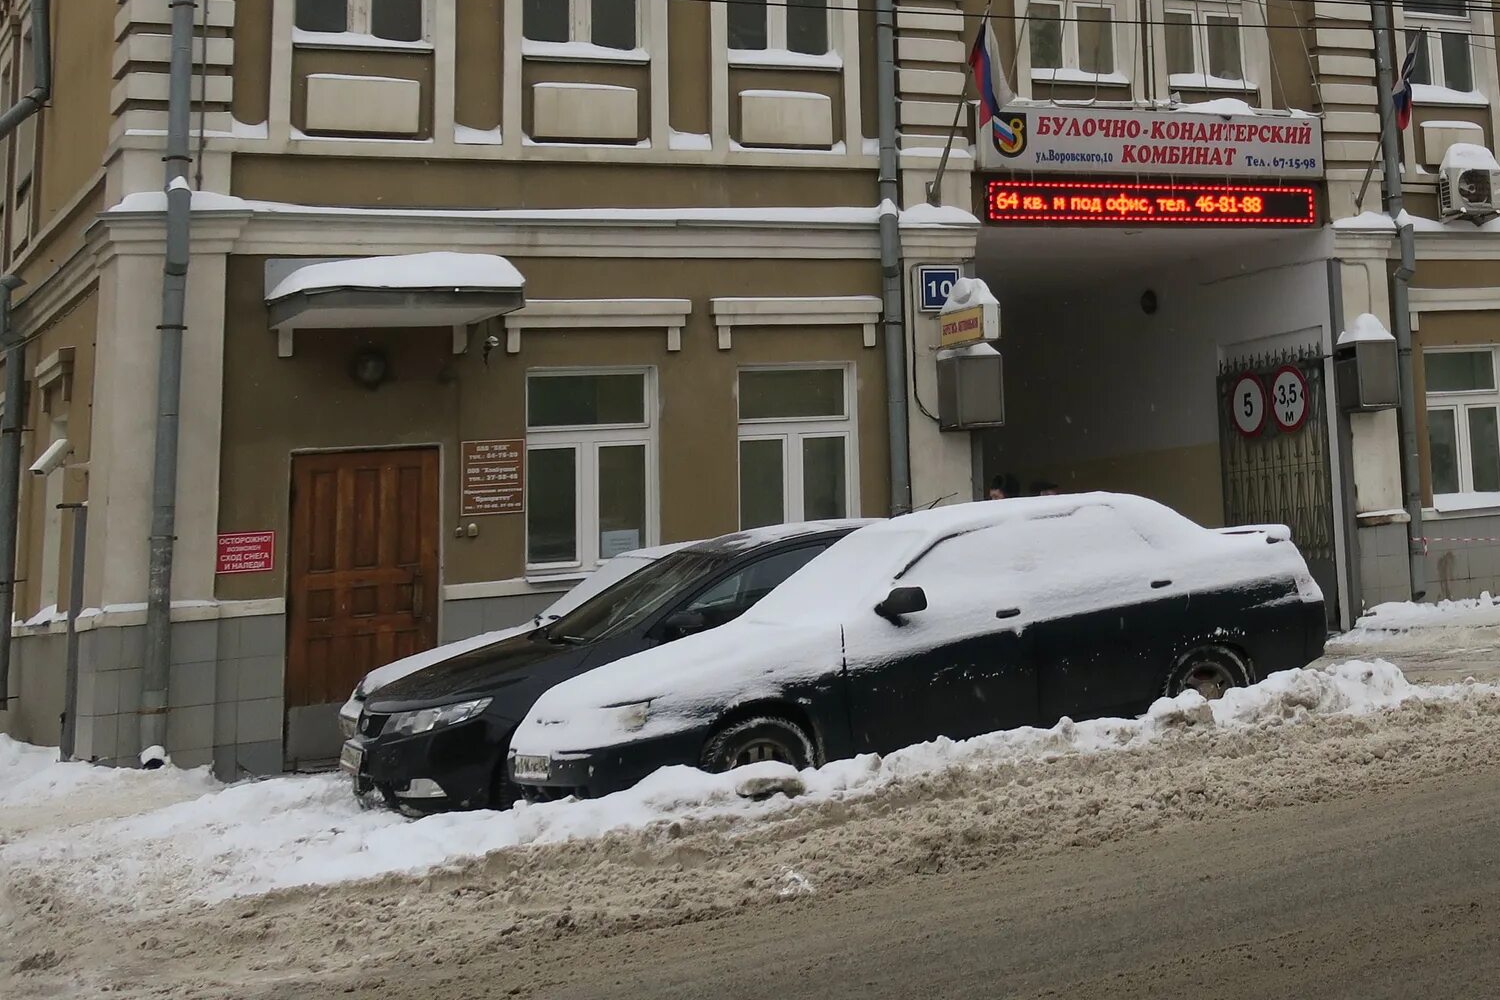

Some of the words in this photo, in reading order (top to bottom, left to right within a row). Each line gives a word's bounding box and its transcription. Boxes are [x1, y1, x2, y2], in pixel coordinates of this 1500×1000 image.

[1036, 116, 1312, 144] БУЛОЧНО-КОНДИТЕРСКИЙ
[1121, 144, 1237, 166] КОМБИНАТ
[996, 192, 1018, 210] 64
[1023, 196, 1048, 210] кв.
[1053, 197, 1065, 210] м
[1071, 197, 1102, 212] под
[1106, 193, 1153, 215] офис,
[1156, 198, 1191, 212] тел.
[1195, 195, 1262, 213] 46-81-88
[927, 280, 954, 298] 10
[1243, 392, 1254, 417] 5
[1278, 383, 1297, 408] 3,5
[219, 535, 271, 545] ОСТОРОЖНО!
[220, 554, 242, 562] СХОД
[243, 552, 269, 560] СНЕГА
[231, 561, 265, 570] НАЛЕДИ
